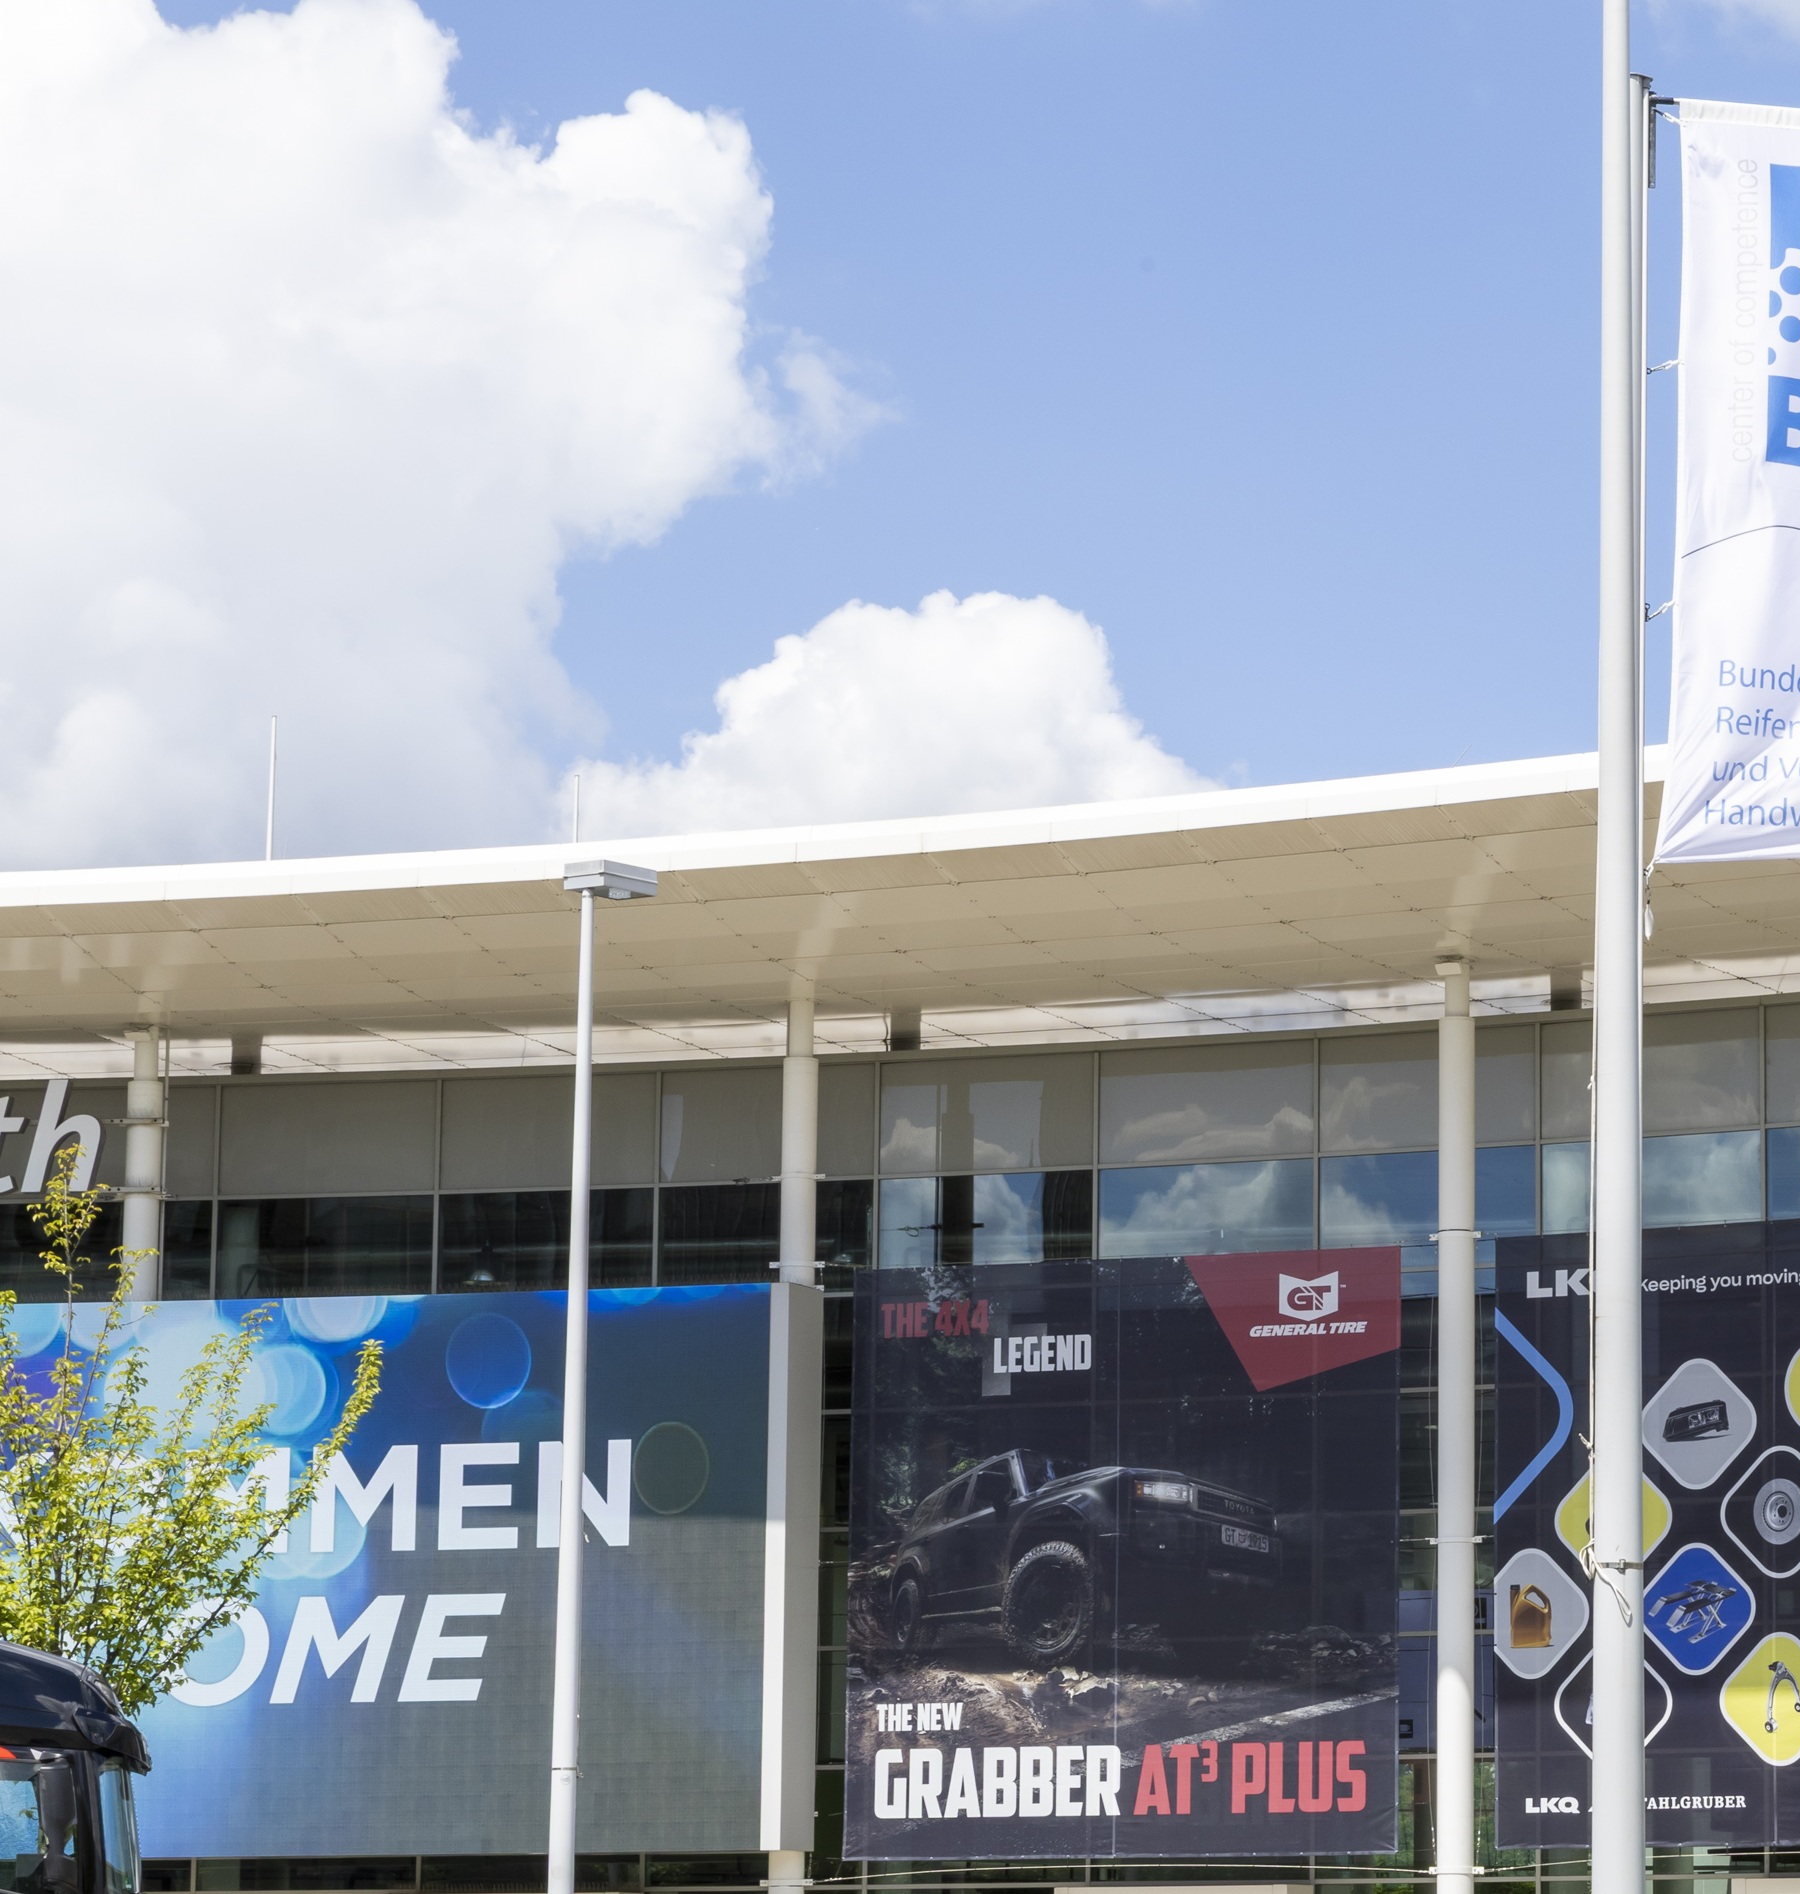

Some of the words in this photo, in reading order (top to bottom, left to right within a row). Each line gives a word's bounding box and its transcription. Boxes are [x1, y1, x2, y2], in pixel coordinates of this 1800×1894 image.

[1732, 159, 1763, 328] competence
[1729, 339, 1755, 365] of
[1727, 377, 1754, 463] center
[1712, 756, 1769, 783] und
[1526, 1268, 1597, 1299] LK
[1710, 1273, 1742, 1291] you
[881, 1302, 929, 1339] THE
[1250, 1322, 1326, 1337] GENERAL
[1329, 1321, 1367, 1334] TIRE
[994, 1334, 1091, 1374] LEGEND
[1224, 1500, 1255, 1515] TOYOTA
[876, 1703, 912, 1732] THE
[917, 1702, 963, 1732] NEW
[874, 1745, 1121, 1819] GRABBER
[1231, 1740, 1366, 1814] PLUS
[1525, 1796, 1580, 1814] LKQ
